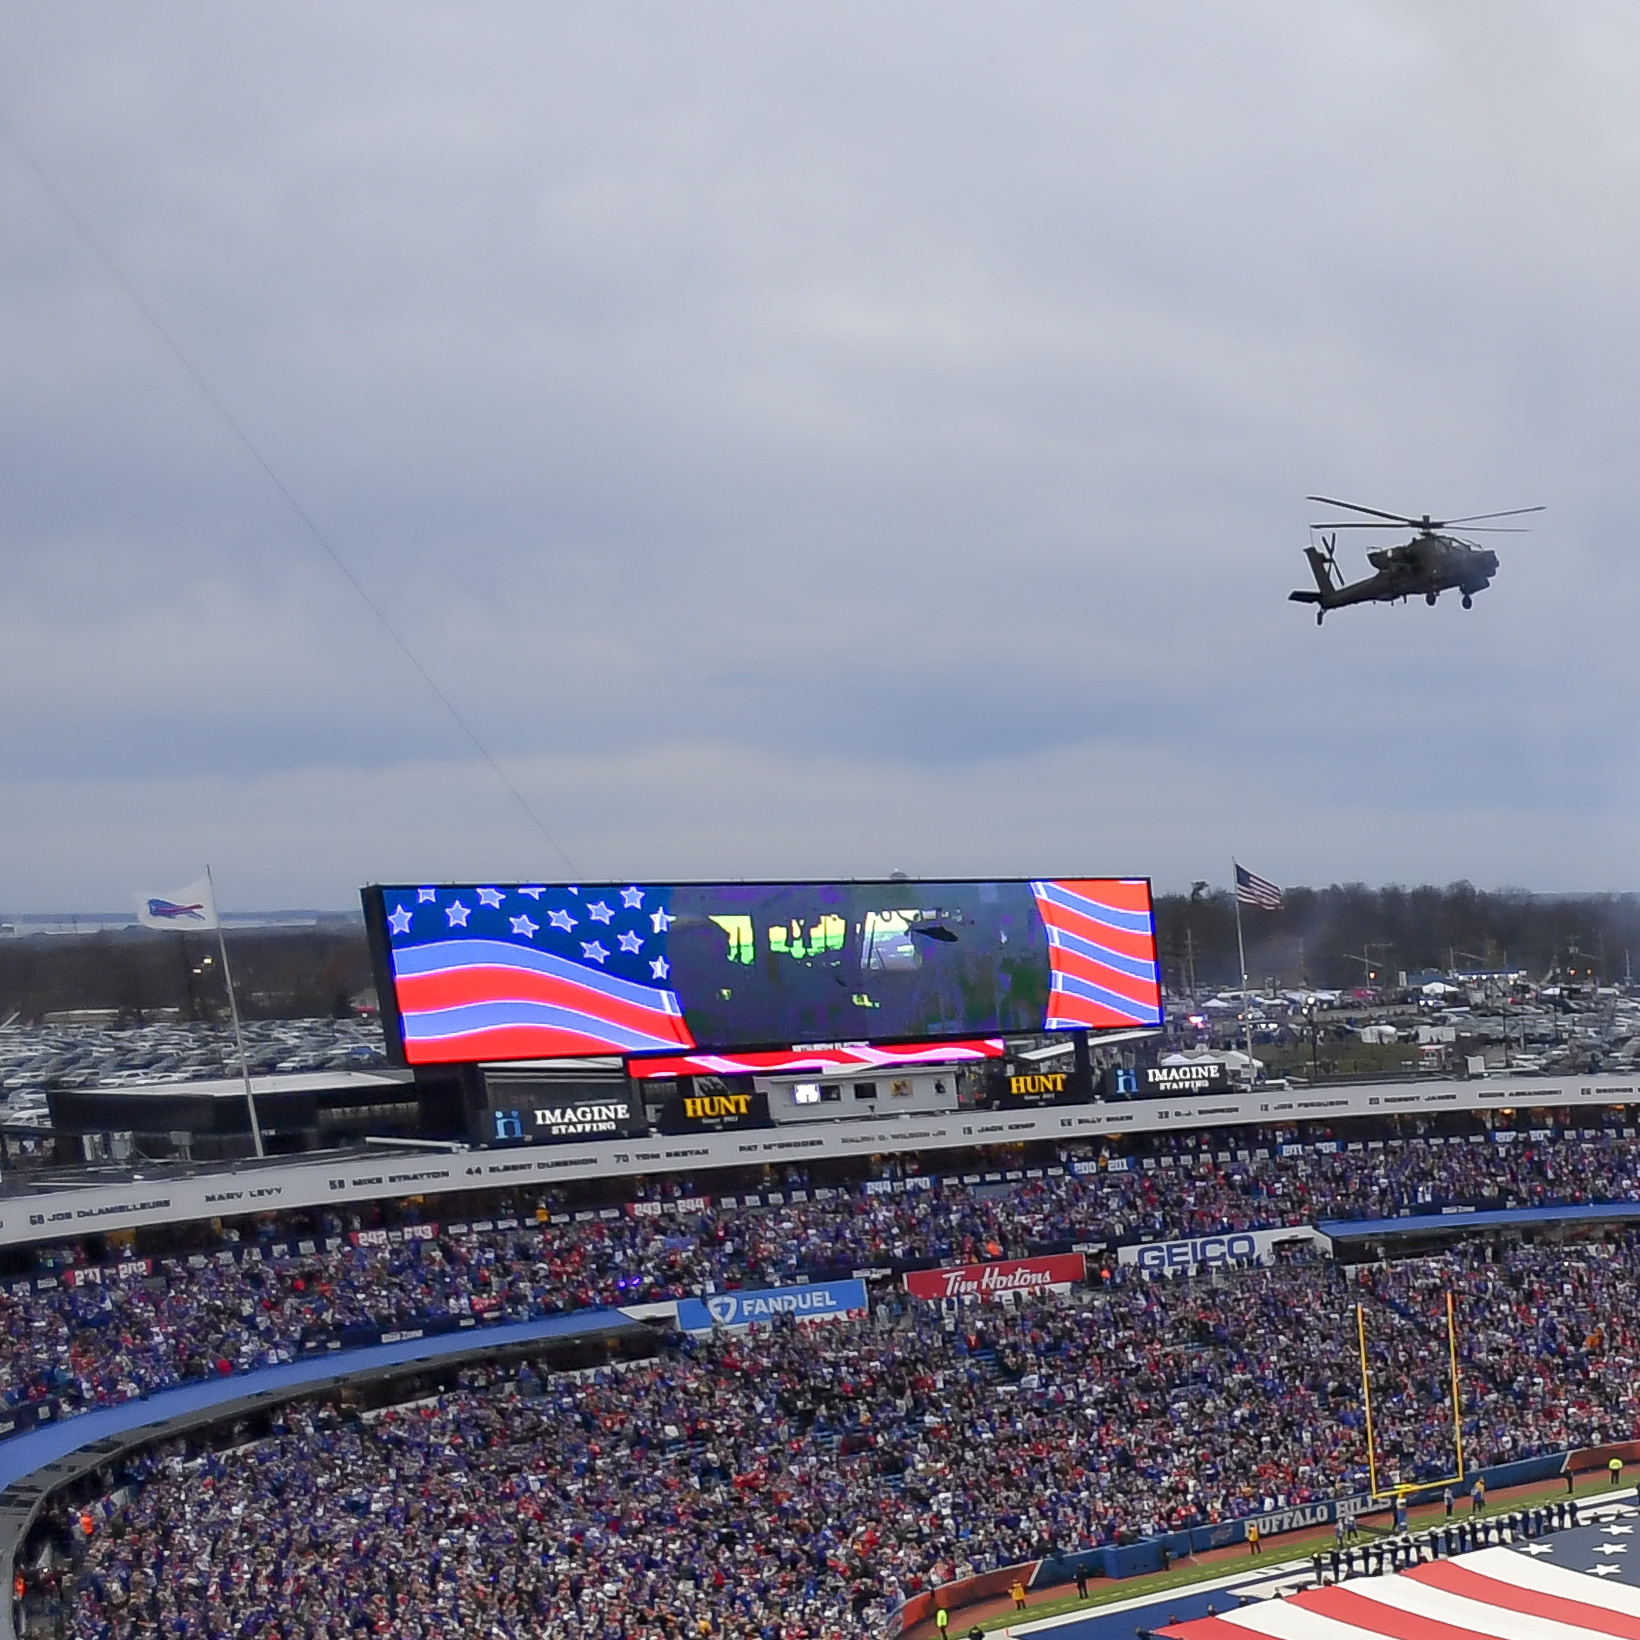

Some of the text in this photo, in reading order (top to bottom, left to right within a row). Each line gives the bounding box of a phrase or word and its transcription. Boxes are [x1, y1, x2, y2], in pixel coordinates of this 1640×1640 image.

[1010, 1072, 1067, 1096] HUNT
[1147, 1064, 1220, 1083] IMAGINE
[534, 1104, 631, 1125] IMAGINE
[684, 1093, 752, 1119] HUNT
[550, 1121, 617, 1136] STAFFING
[465, 1165, 483, 1177] 44
[205, 1186, 283, 1203] MARV LEVY
[48, 1210, 73, 1223] JOE
[1136, 1234, 1256, 1271] GEICO
[941, 1266, 1052, 1296] Tim Hortons
[742, 1290, 837, 1316] FANDUEL
[1244, 1495, 1393, 1537] BUFFALO BILLS
